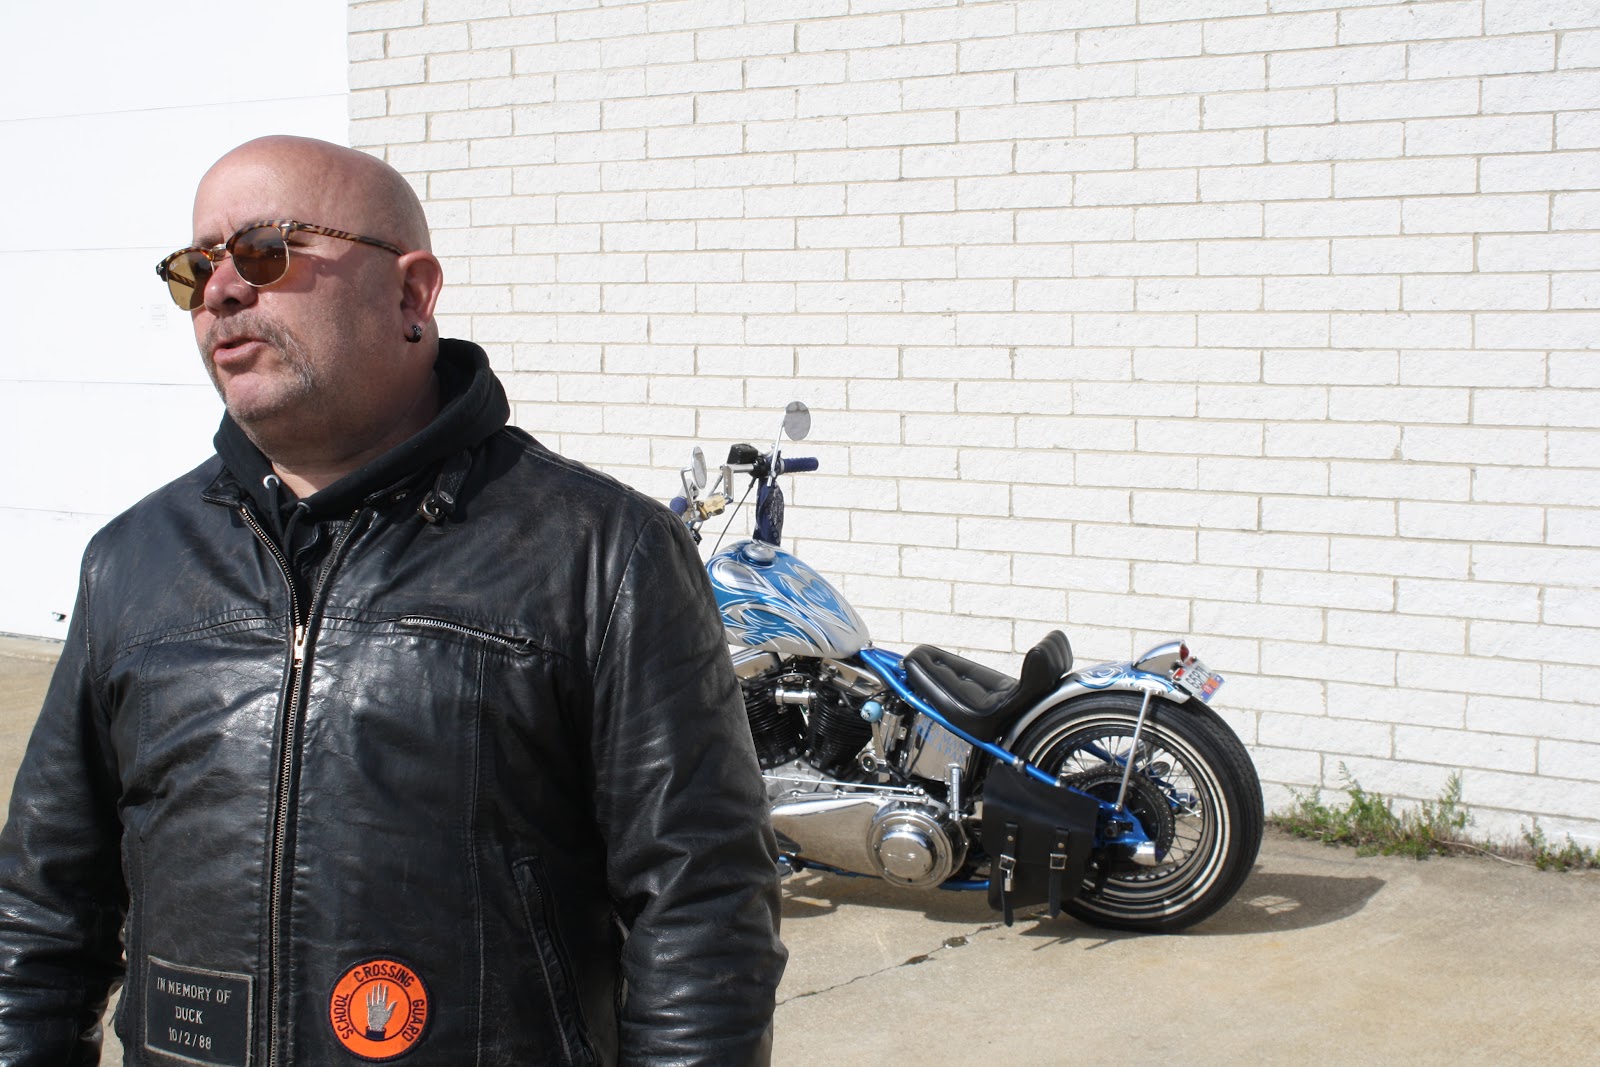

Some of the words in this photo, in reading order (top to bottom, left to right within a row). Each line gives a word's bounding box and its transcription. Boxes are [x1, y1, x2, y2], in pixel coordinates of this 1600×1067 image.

[156, 976, 166, 990] IN
[168, 980, 212, 1002] MEMORY
[216, 989, 232, 1005] OF
[333, 993, 354, 1040] SCHOOL
[353, 963, 415, 988] CROSSING
[401, 998, 425, 1042] GUARD
[175, 1005, 204, 1025] DUCK
